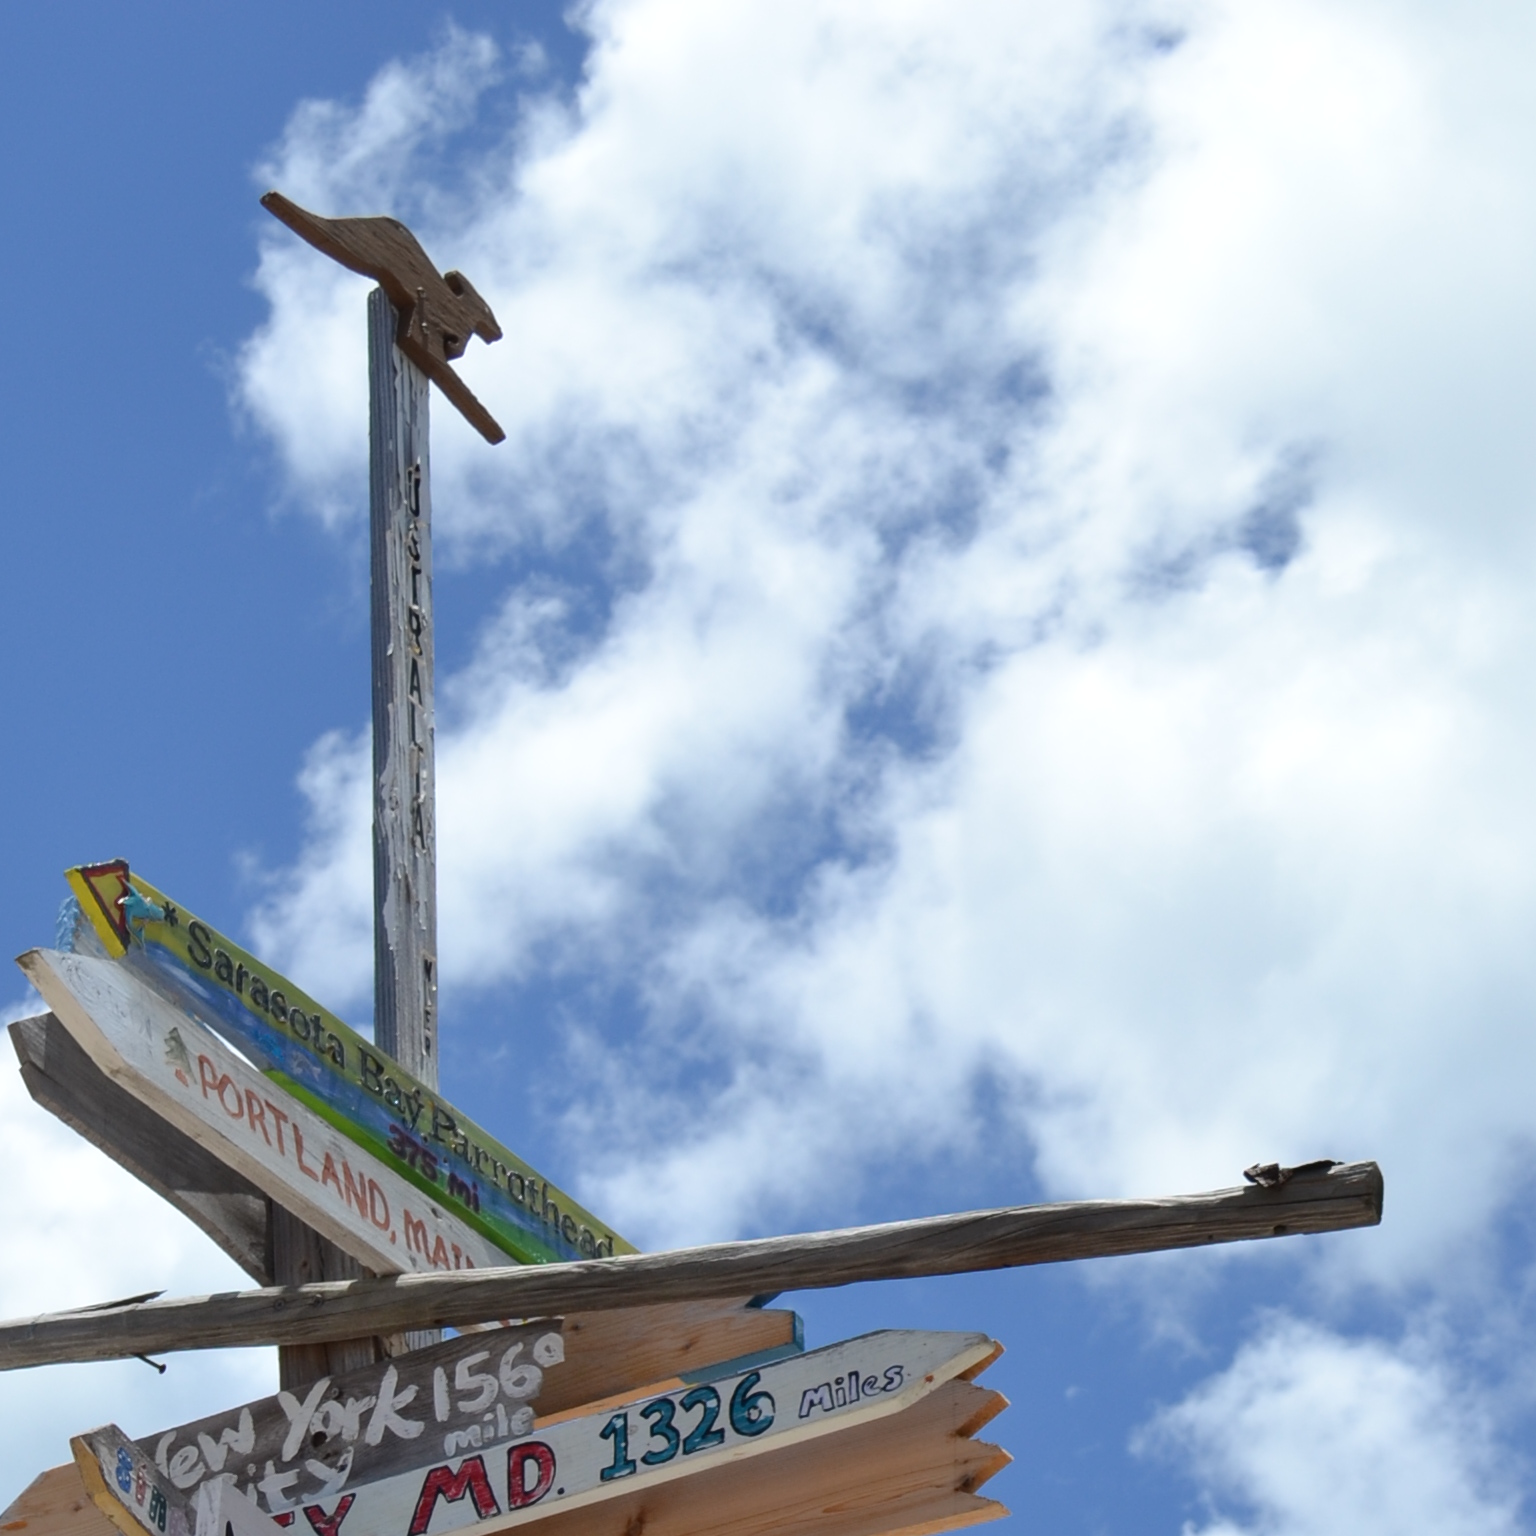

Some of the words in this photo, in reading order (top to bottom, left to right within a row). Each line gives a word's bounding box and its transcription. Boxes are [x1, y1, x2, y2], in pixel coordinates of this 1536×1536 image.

[186, 918, 348, 1069] Sarasota
[362, 1045, 424, 1132] Bay
[197, 1053, 398, 1246] PORTLAND,
[386, 1123, 440, 1182] 375
[278, 1364, 424, 1462] York
[600, 1372, 776, 1482] 1326
[798, 1365, 904, 1419] Miles
